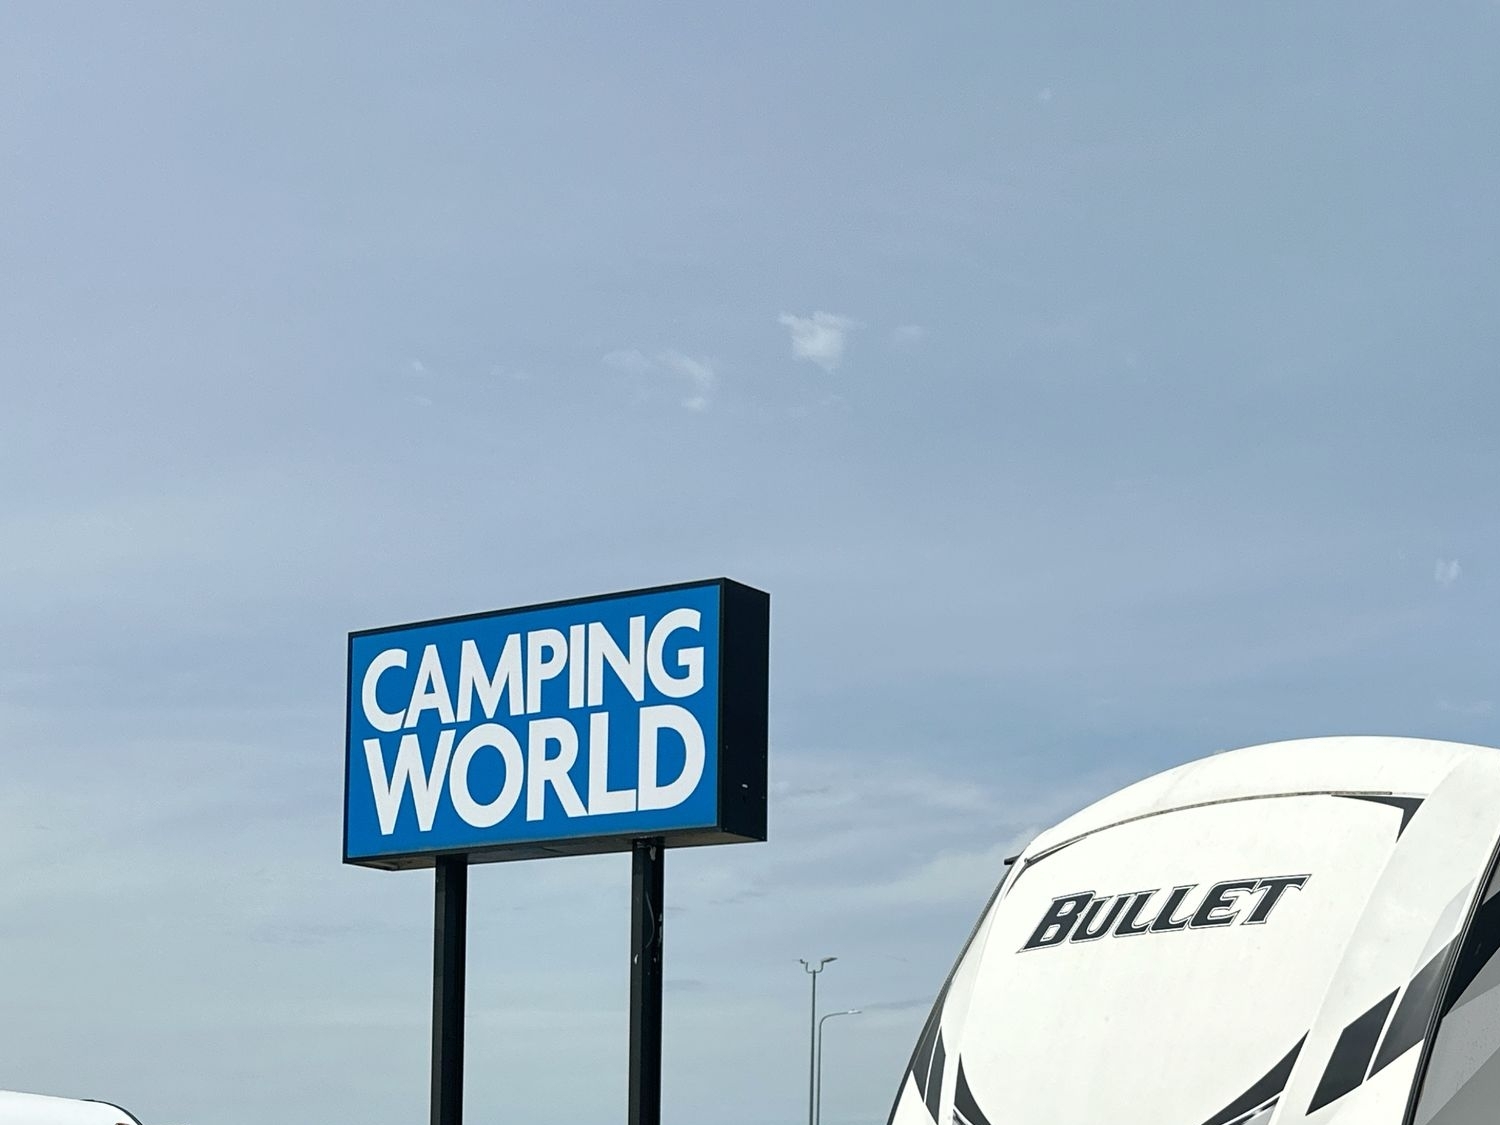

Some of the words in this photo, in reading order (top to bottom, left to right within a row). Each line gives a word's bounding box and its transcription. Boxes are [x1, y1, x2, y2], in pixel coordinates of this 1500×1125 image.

[362, 608, 704, 732] CAMPING
[363, 704, 706, 836] WORLD
[1016, 874, 1312, 954] BULLET
